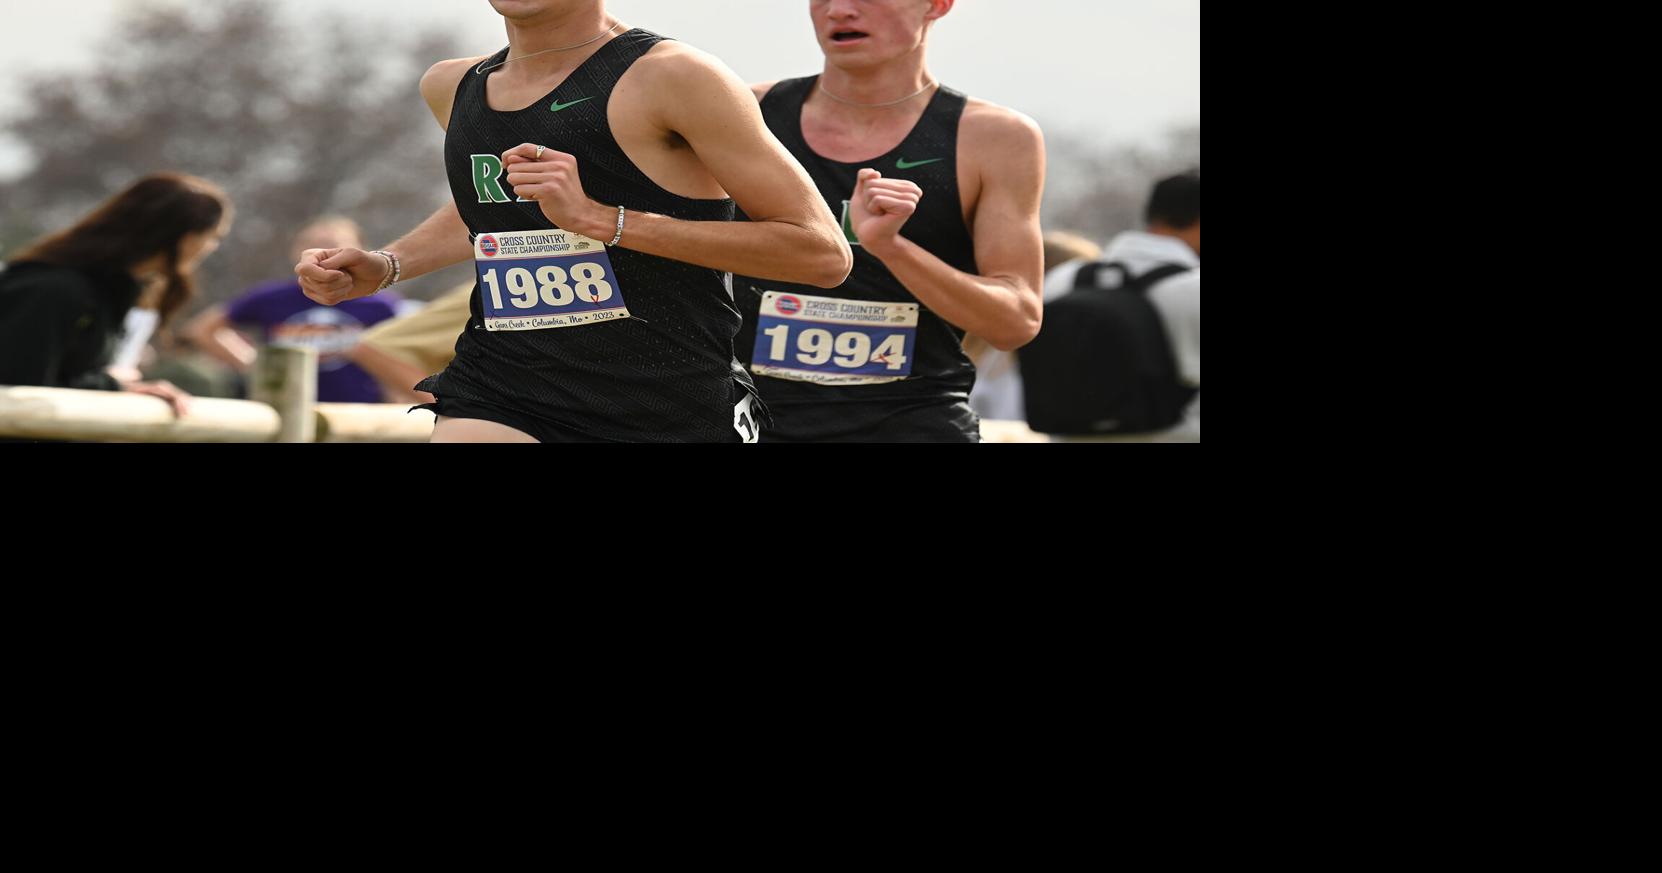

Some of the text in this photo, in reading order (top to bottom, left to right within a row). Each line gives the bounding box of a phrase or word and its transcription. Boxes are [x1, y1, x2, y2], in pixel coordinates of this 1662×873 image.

[470, 154, 541, 203] R
[499, 235, 525, 247] CROSS
[526, 233, 566, 245] COUNTRY
[500, 246, 519, 255] STATE
[519, 243, 571, 254] CHAMPIONSHIP
[482, 262, 613, 310] 1988
[805, 300, 838, 312] CROSS
[840, 303, 888, 315] COUNTRY
[567, 315, 583, 324] Mo
[592, 311, 615, 321] 2023
[804, 309, 826, 319] STATE
[828, 311, 889, 322] CHAMPIONSHIP
[763, 324, 907, 370] 1994
